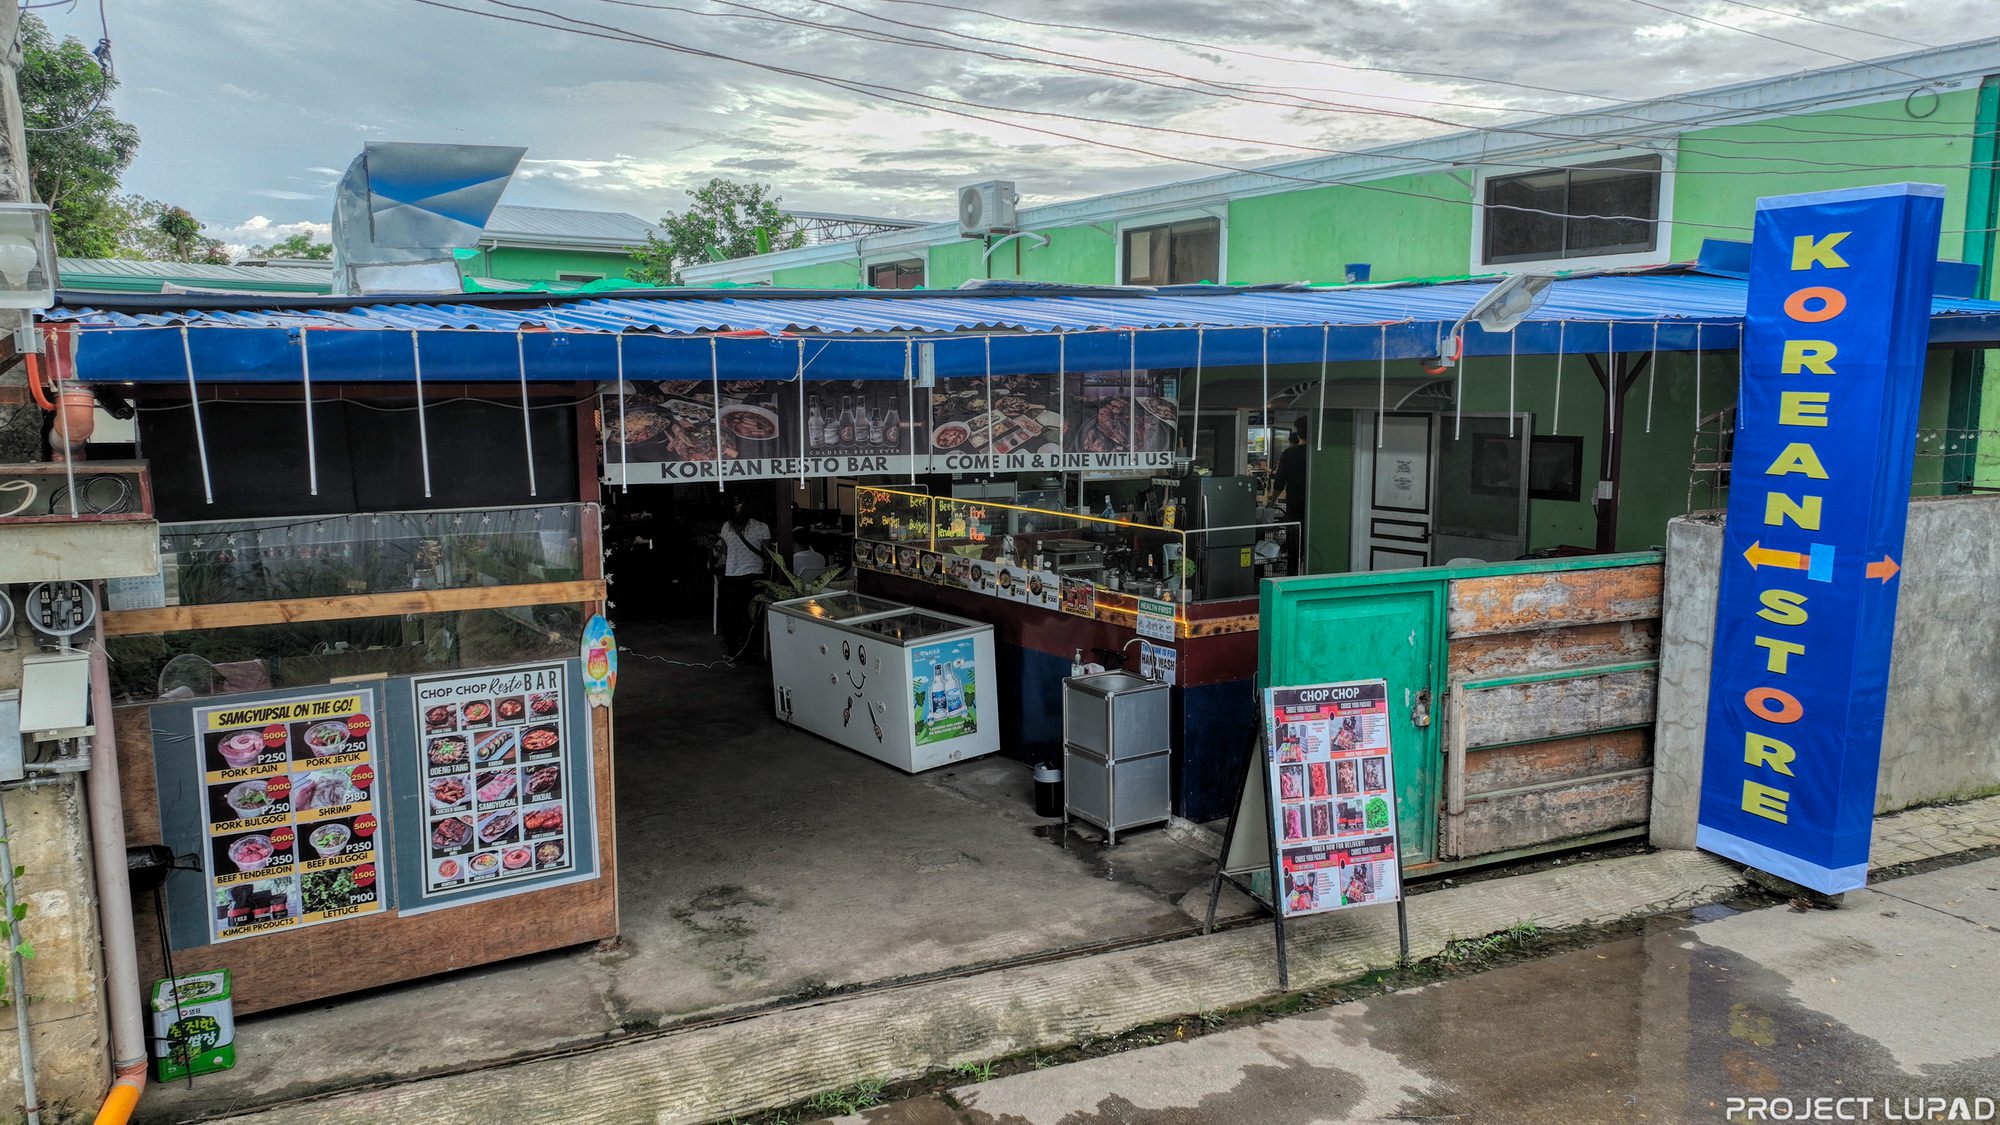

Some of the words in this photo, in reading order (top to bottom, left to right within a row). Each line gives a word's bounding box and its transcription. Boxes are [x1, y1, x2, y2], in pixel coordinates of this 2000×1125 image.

[1764, 231, 1852, 530] KOREAN
[945, 453, 1000, 470] COME
[1006, 454, 1025, 468] IN
[1031, 453, 1044, 468] &
[1050, 453, 1091, 467] DINE
[1096, 452, 1140, 467] WITH
[1145, 451, 1174, 466] US!
[660, 459, 762, 479] KOREAN
[770, 456, 839, 476] RESTO
[847, 456, 889, 473] BAR
[969, 505, 986, 519] Pork
[1141, 602, 1158, 612] HEALTH
[1158, 604, 1172, 615] FIRST
[421, 687, 453, 700] CHOP
[456, 684, 487, 696] CHOP
[489, 675, 523, 695] Resto
[524, 670, 557, 691] BAR
[1300, 690, 1329, 702] CHOP
[1331, 687, 1360, 700] CHOP
[218, 705, 290, 726] SAMGYUPSAL
[293, 703, 310, 721] ON
[312, 700, 332, 716] THE
[332, 698, 353, 713] GO!
[1741, 589, 1809, 825] STORE
[347, 720, 371, 730] 500G
[263, 731, 288, 740] 500G
[339, 741, 366, 753] P250
[257, 751, 286, 764] P250
[306, 757, 331, 768] PORK
[333, 753, 360, 764] JEYUK
[221, 768, 248, 779] PORK
[250, 764, 278, 774] PLAIN
[452, 763, 469, 774] TANG
[351, 772, 374, 781] 250G
[267, 782, 291, 792] 500G
[344, 791, 368, 803] P180
[261, 803, 290, 815] P250
[318, 805, 352, 817] SHRIMP
[478, 798, 518, 811] SAMGYUPSAL
[215, 822, 243, 831] PORK
[245, 815, 286, 827] BULGOGI
[354, 821, 377, 830] 500G
[271, 834, 294, 843] 500G
[345, 841, 372, 853] P350
[265, 854, 293, 866] P350
[307, 860, 327, 869] BEEF
[329, 853, 368, 865] BULGOGI
[217, 874, 237, 884] BEEF
[239, 865, 292, 880] TENDERLOIN
[354, 870, 375, 879] 150G
[350, 893, 374, 904] P100
[322, 905, 359, 919] LETTUCE
[223, 925, 251, 937] KIMCHI
[253, 917, 294, 932] PRODUCTS
